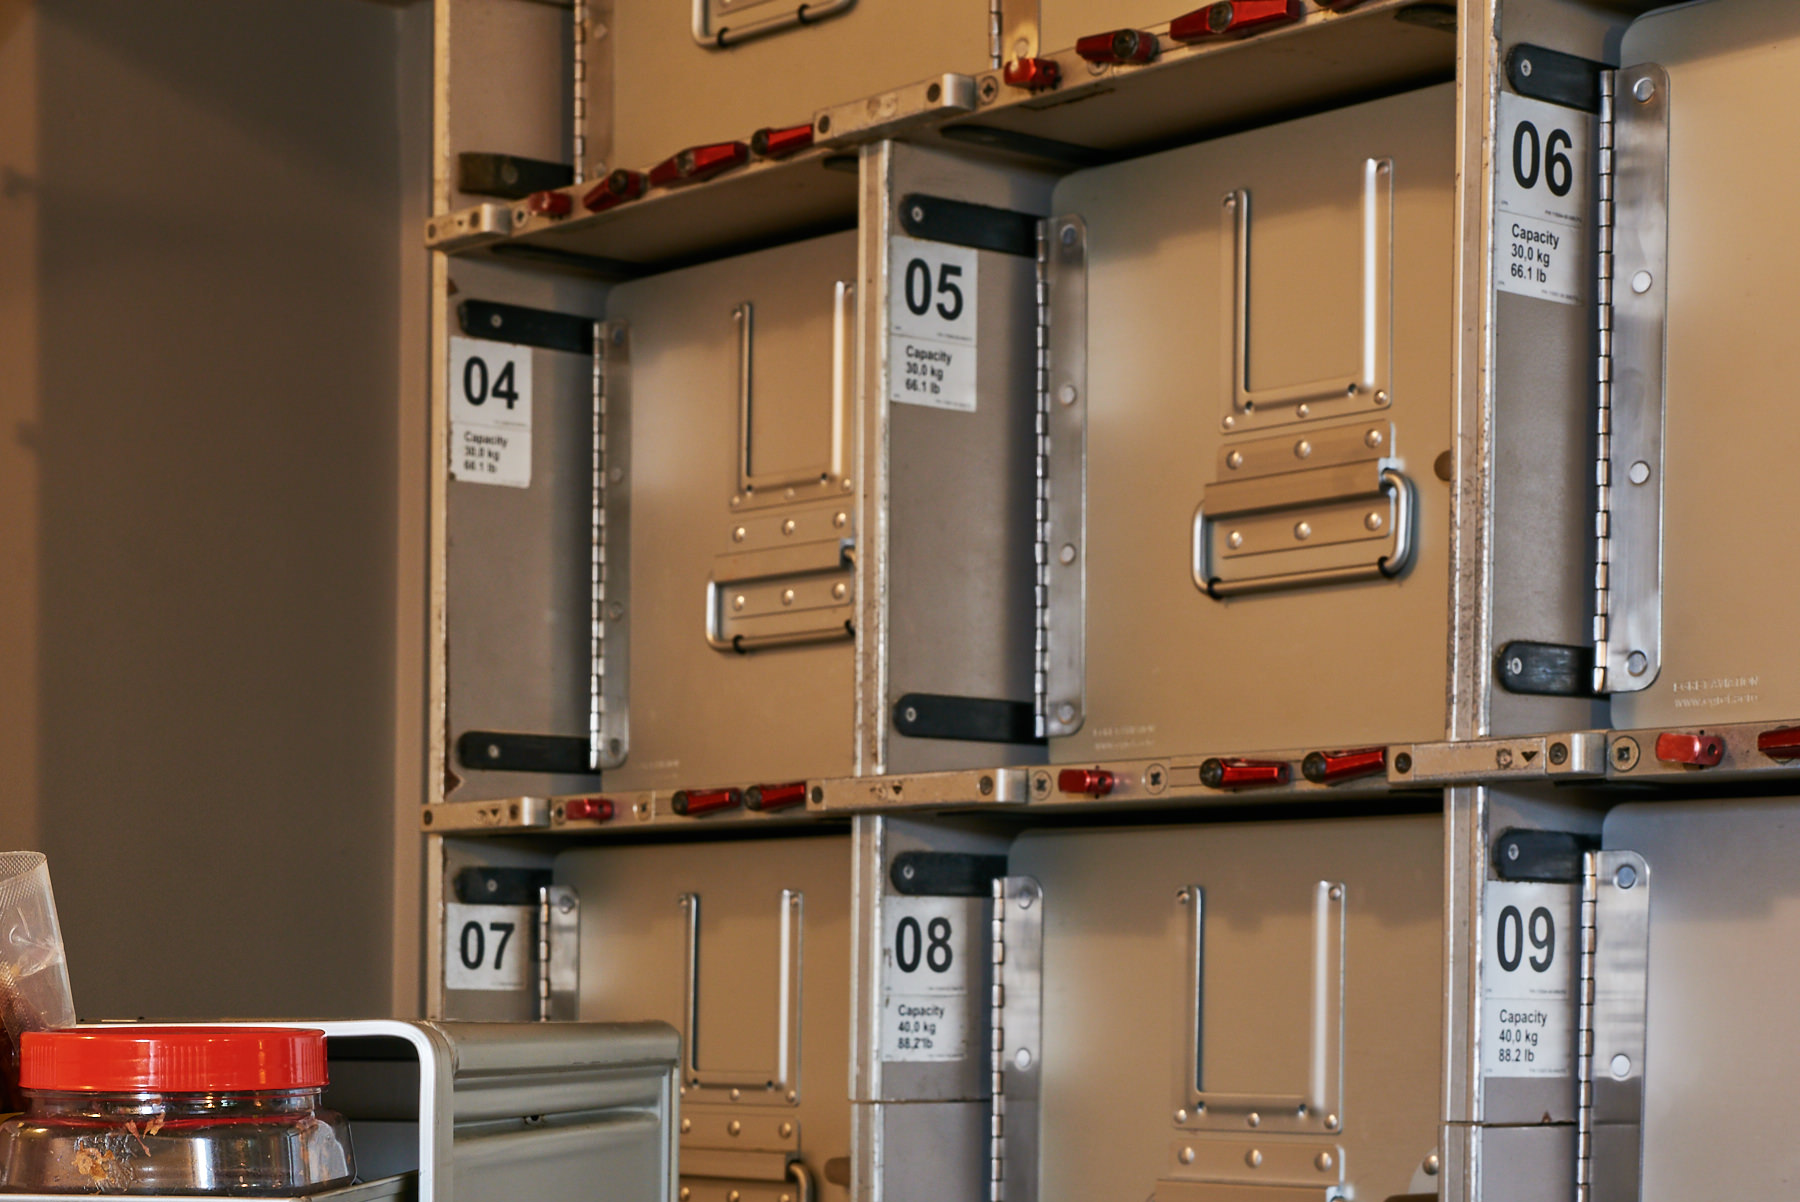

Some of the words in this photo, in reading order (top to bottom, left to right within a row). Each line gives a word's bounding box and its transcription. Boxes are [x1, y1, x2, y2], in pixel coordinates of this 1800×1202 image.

[1513, 120, 1572, 197] 06
[1512, 224, 1559, 250] Capacity
[1511, 244, 1533, 262] 30,0
[1537, 249, 1550, 267] kg
[1511, 263, 1532, 280] 66.1
[1537, 268, 1546, 283] lb
[905, 258, 963, 321] 05
[906, 345, 952, 366] Capacity
[464, 356, 519, 409] 04
[930, 366, 943, 381] kg
[906, 378, 926, 392] 66.1
[931, 382, 940, 394] lb
[464, 431, 508, 448] Capacity
[487, 450, 500, 461] kg
[461, 921, 515, 970] 07
[895, 916, 953, 973] 08
[1497, 905, 1555, 972] 09
[898, 1004, 945, 1019] Capacity
[1500, 1009, 1547, 1027] Capacity
[924, 1021, 936, 1035] kg
[1499, 1029, 1521, 1044] 40,0
[1525, 1029, 1538, 1046] kg
[1499, 1048, 1521, 1062] 88.2
[1525, 1049, 1534, 1062] lb
